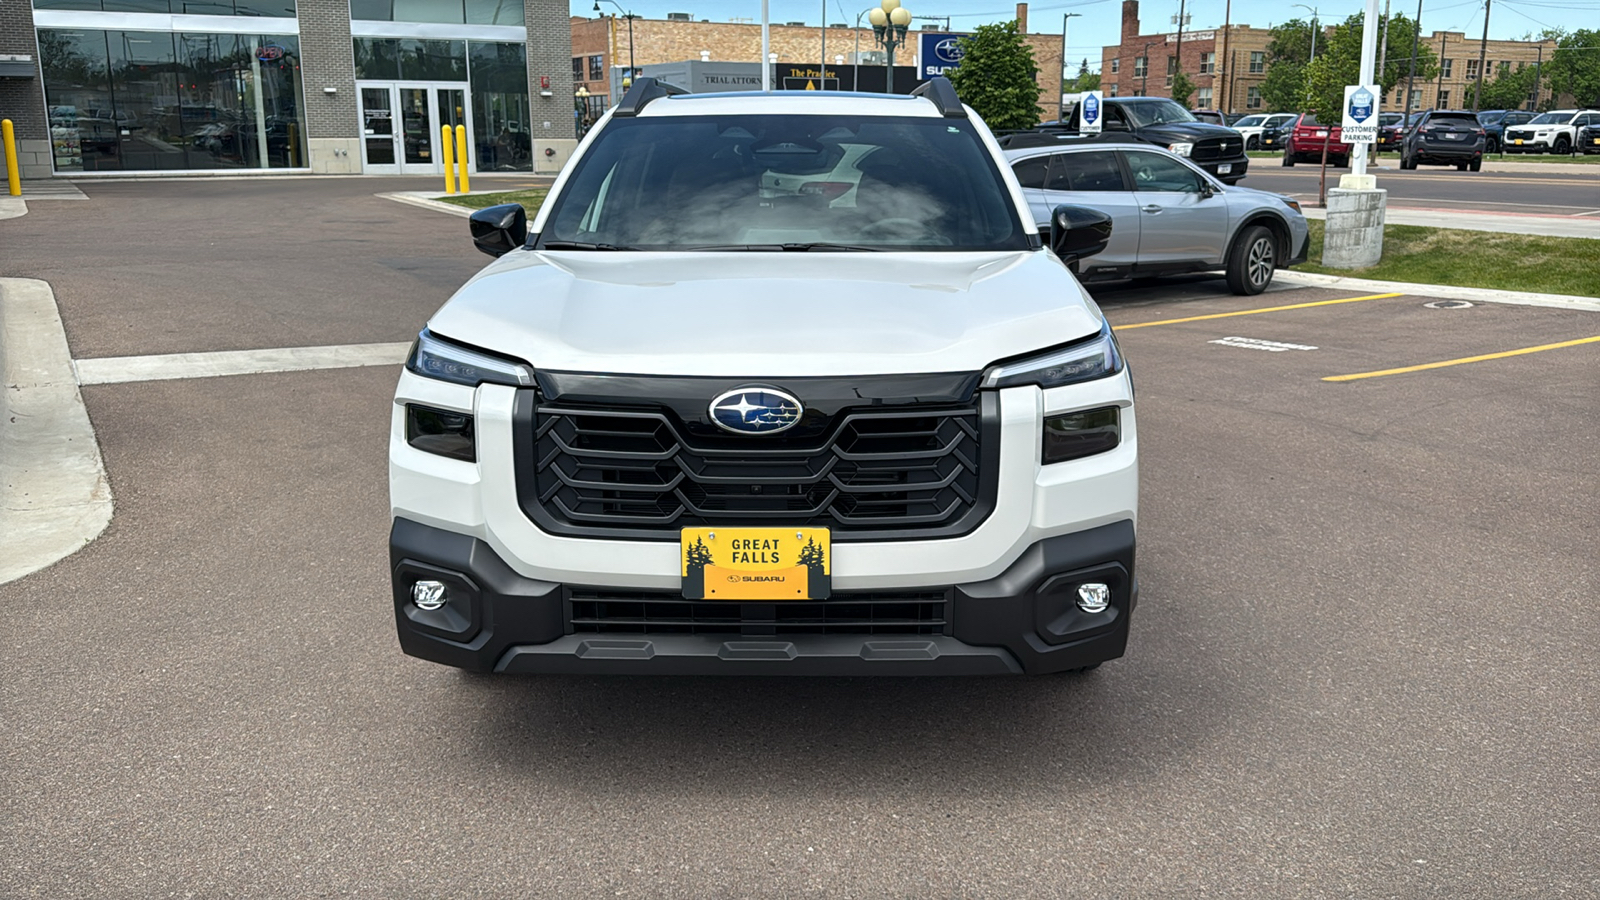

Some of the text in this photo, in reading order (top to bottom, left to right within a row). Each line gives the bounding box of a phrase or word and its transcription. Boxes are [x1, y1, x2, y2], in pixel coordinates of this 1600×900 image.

[256, 46, 282, 58] OPEN
[790, 69, 836, 78] The Pracice
[705, 76, 776, 85] TRIAL ATTORNS
[732, 539, 780, 550] GREAT
[732, 552, 780, 563] FALLS
